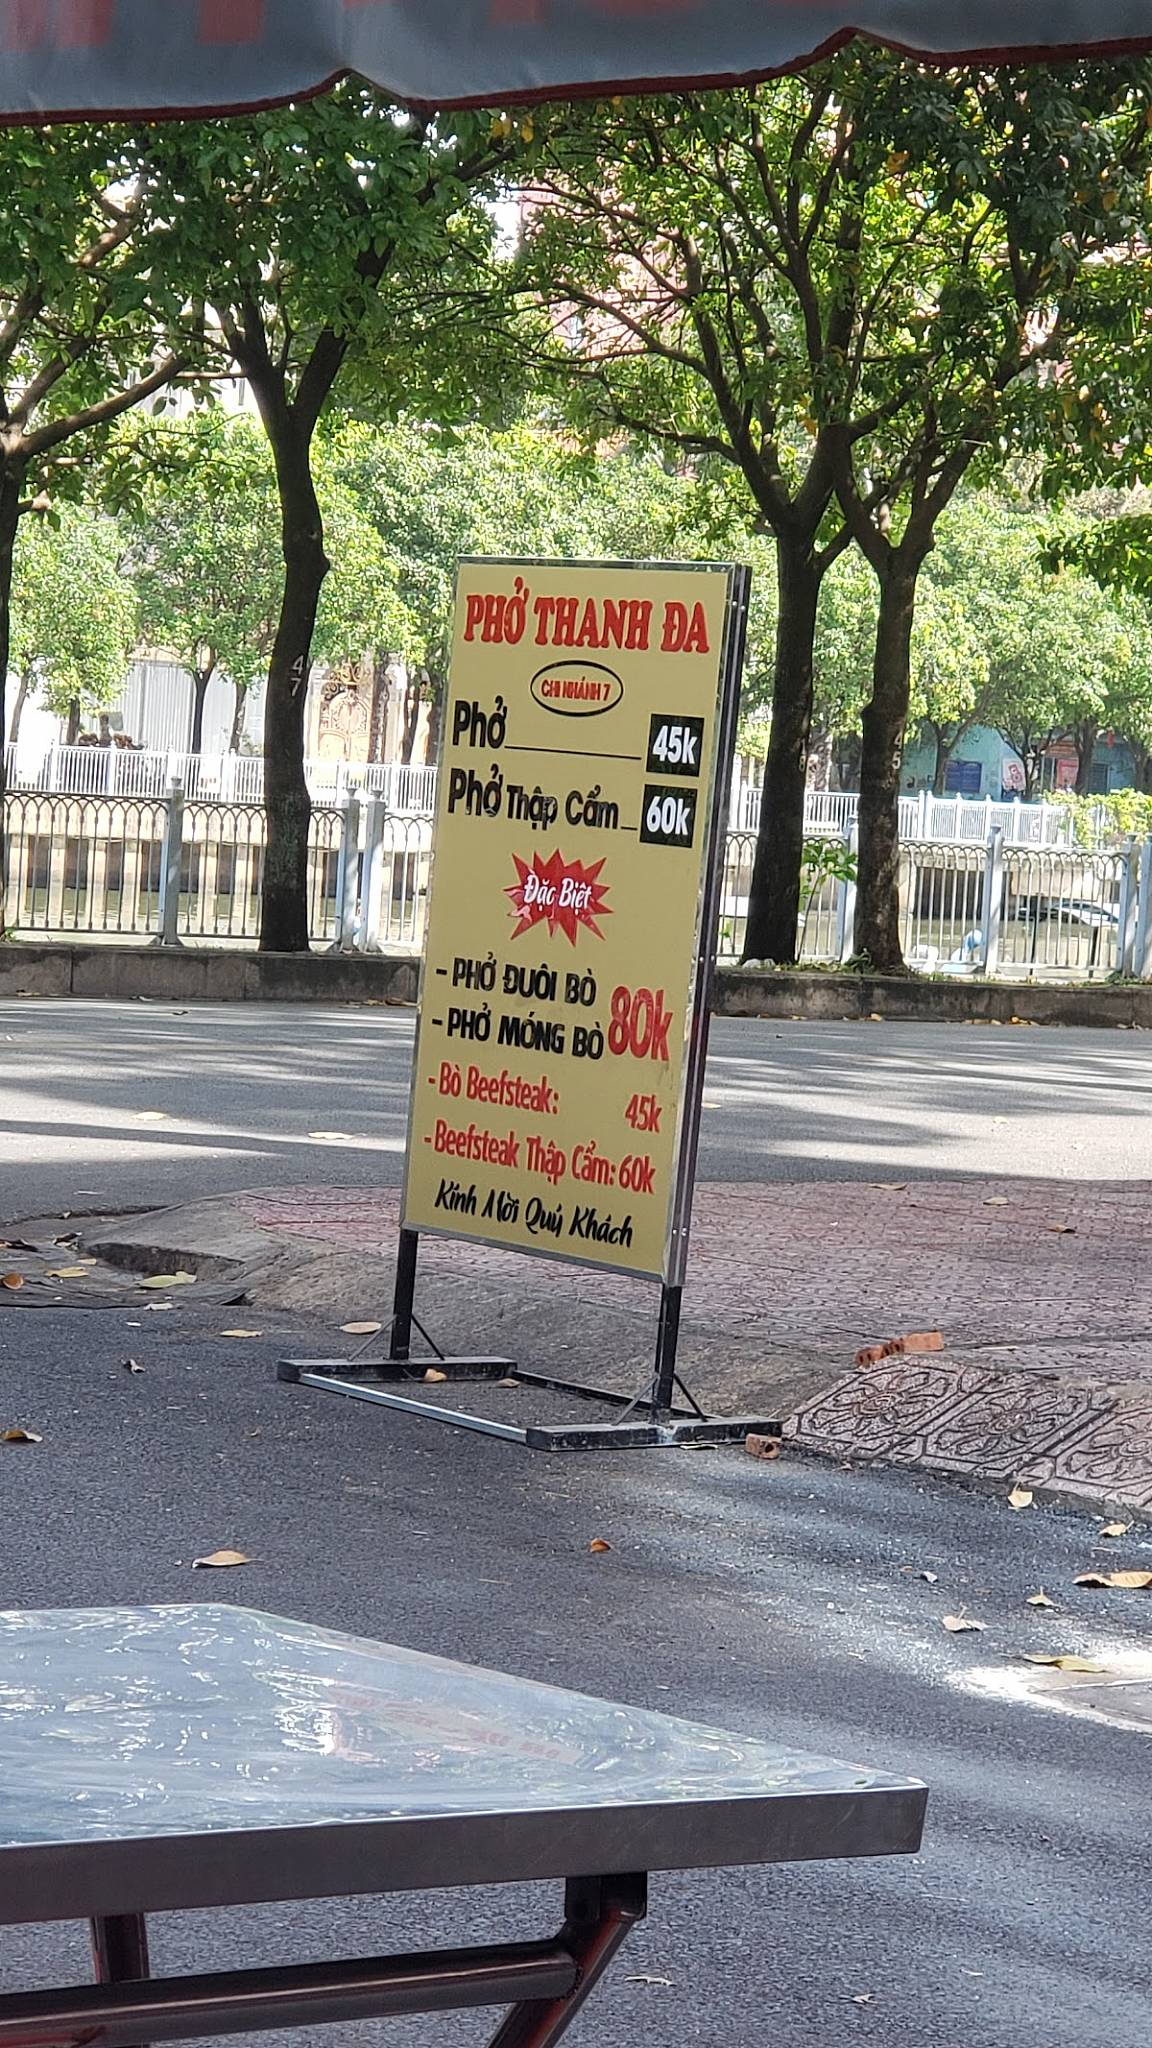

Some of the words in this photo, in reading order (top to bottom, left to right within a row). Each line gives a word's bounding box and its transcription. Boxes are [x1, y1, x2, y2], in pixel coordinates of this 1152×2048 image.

[463, 576, 530, 645] PHỞ
[533, 596, 653, 651] THANH
[660, 601, 710, 653] ĐA
[541, 679, 561, 699] CHI
[562, 676, 601, 701] NHÁNH
[603, 684, 611, 701] 7
[452, 695, 508, 749] Phở
[652, 725, 698, 764] 45k
[448, 763, 504, 817] Phở
[506, 784, 558, 831] Thập
[565, 784, 619, 830] Cẩm
[646, 796, 692, 836] 60k
[523, 870, 556, 912] Đặc
[559, 877, 593, 915] Biệt
[502, 963, 558, 1001] ĐUÔI
[564, 967, 597, 1007] BÒ
[497, 1011, 566, 1053] MÓNG
[572, 1021, 605, 1060] BÒ
[608, 986, 674, 1061] 80k
[466, 1065, 560, 1114] Beefsteak:
[624, 1093, 662, 1133] 45k
[526, 1135, 566, 1186] Thập
[618, 1154, 657, 1195] 60k
[434, 1178, 476, 1216] Kính
[525, 1197, 562, 1238] Quý
[568, 1205, 633, 1248] Khách
